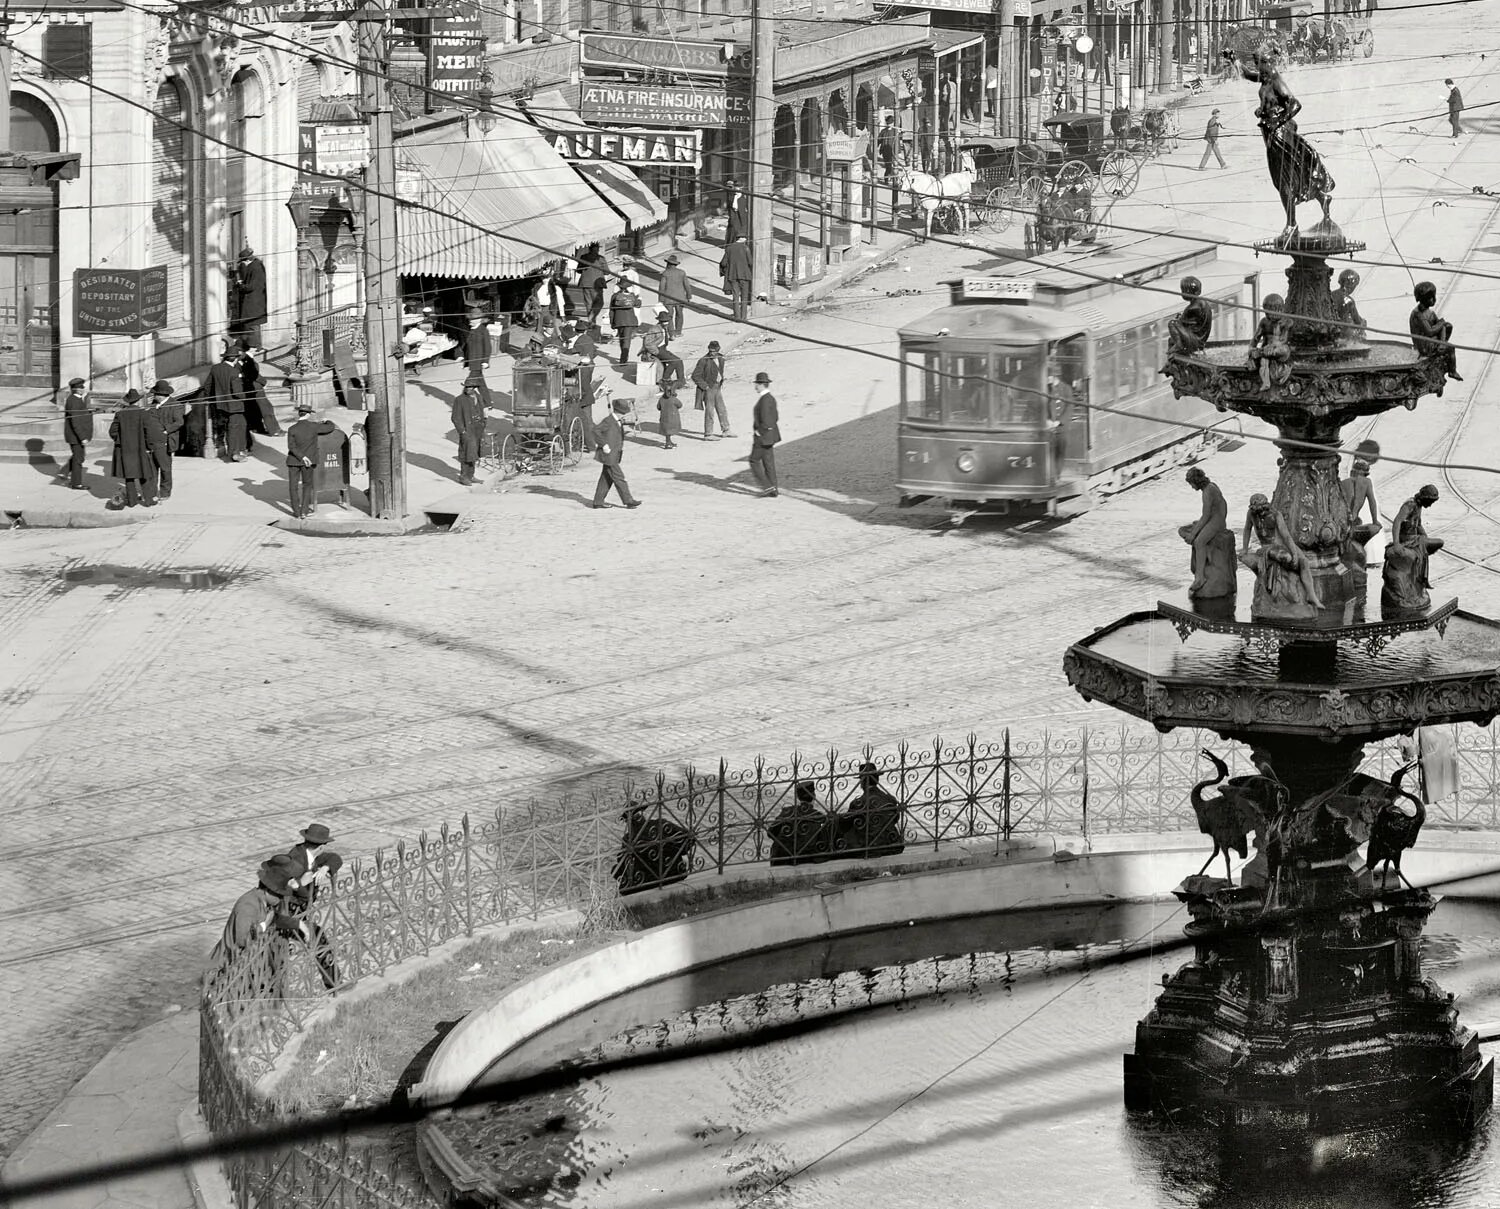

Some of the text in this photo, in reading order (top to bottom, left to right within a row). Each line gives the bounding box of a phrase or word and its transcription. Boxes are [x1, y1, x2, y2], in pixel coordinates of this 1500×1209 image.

[432, 31, 482, 46] KAUFMA
[436, 55, 481, 70] MENS
[432, 79, 482, 92] OUTFITTE
[627, 91, 657, 106] FIRE
[553, 134, 694, 163] AUFMAN
[80, 275, 136, 290] DESIGNATED
[81, 292, 136, 302] DEPOSITARY
[79, 310, 138, 327] UNITED STATES
[1007, 455, 1035, 468] 74
